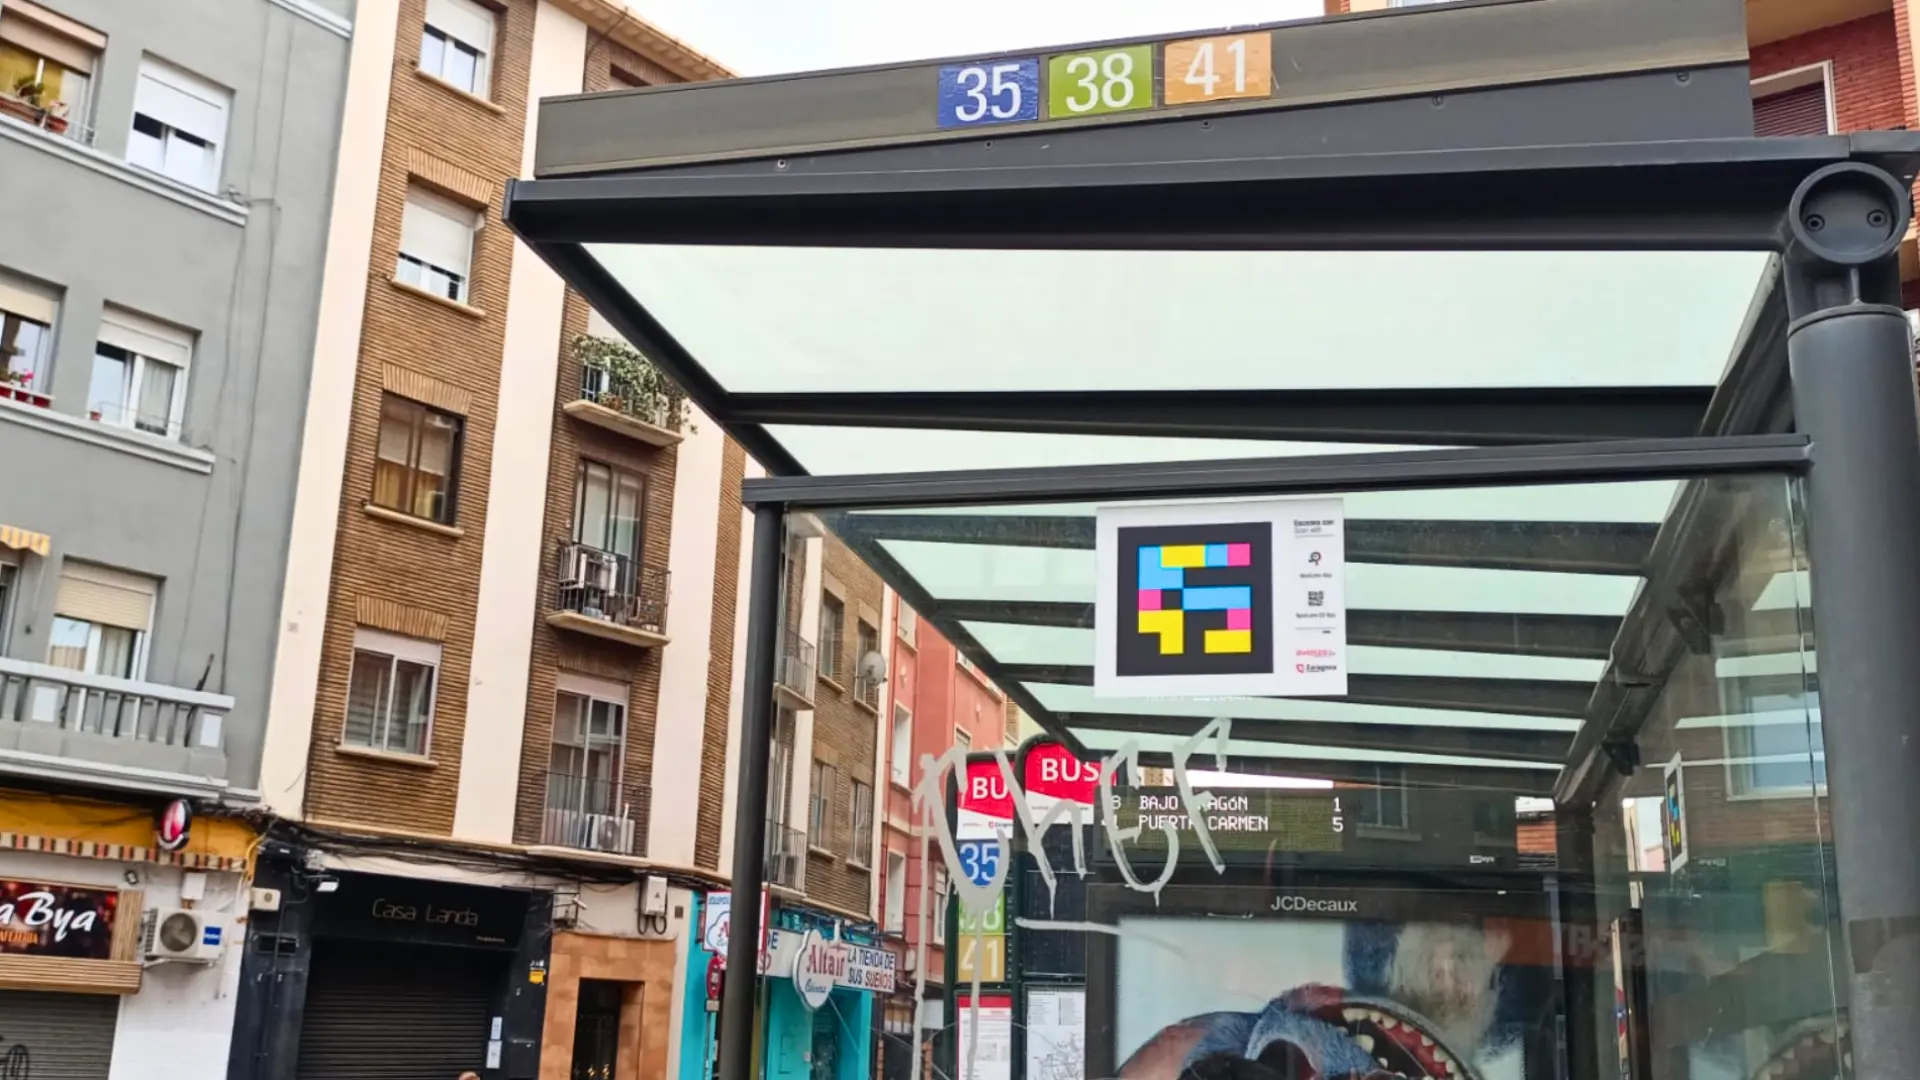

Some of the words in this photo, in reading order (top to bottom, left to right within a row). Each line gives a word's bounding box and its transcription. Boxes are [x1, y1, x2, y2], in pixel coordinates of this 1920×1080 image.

[1183, 39, 1247, 95] 41
[955, 64, 1022, 122] 35
[1065, 52, 1134, 112] 38
[1041, 757, 1100, 783] BUS
[972, 776, 1009, 800] BU
[1139, 795, 1179, 811] BAJO
[1333, 796, 1342, 812] 1
[1207, 815, 1269, 832] CARMEN
[1332, 816, 1344, 832] 5
[959, 843, 1001, 883] 35
[17, 891, 97, 943] Bya
[373, 898, 417, 921] Casa
[425, 904, 479, 927] Landa
[1270, 896, 1359, 913] JCDecaux
[806, 944, 845, 977] Altair
[848, 947, 857, 963] LA
[859, 949, 883, 968] TIENDA
[885, 954, 895, 971] DE
[848, 966, 863, 986] SUS
